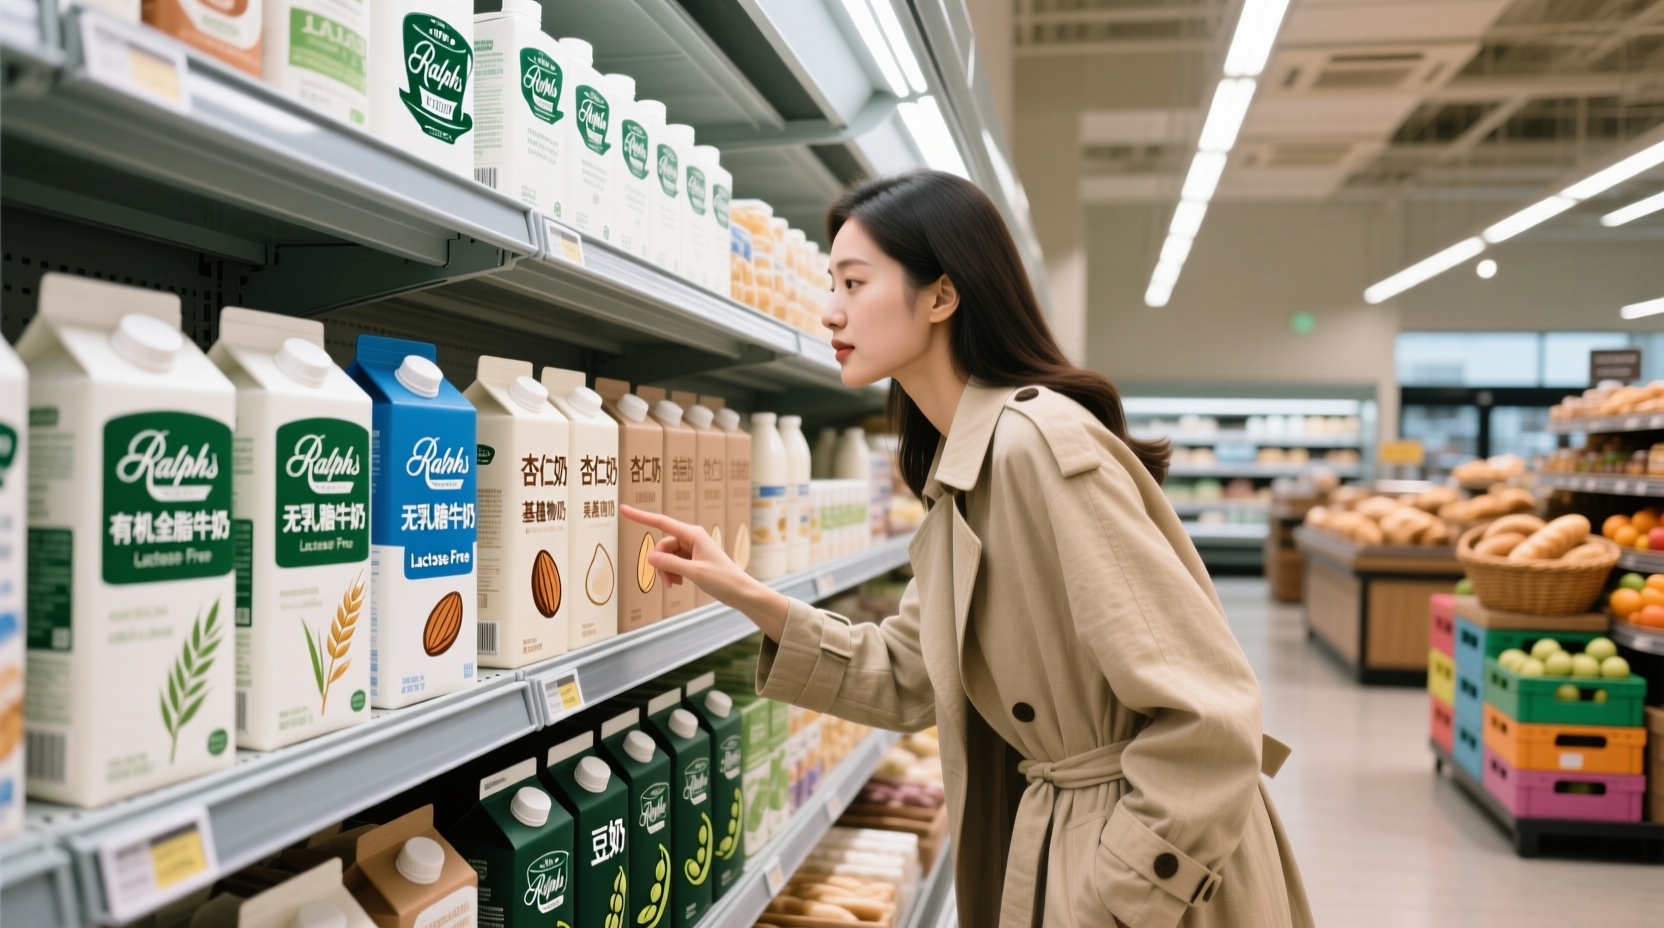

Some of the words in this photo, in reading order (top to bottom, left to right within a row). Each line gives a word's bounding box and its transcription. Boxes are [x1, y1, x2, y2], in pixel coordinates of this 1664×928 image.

[408, 40, 463, 92] Ralphs
[116, 429, 219, 486] Ralphs
[286, 434, 360, 482] Ralphs
[521, 453, 568, 487] 杏仁奶
[580, 454, 618, 486] 杏仁奶
[591, 818, 625, 866] 豆奶
